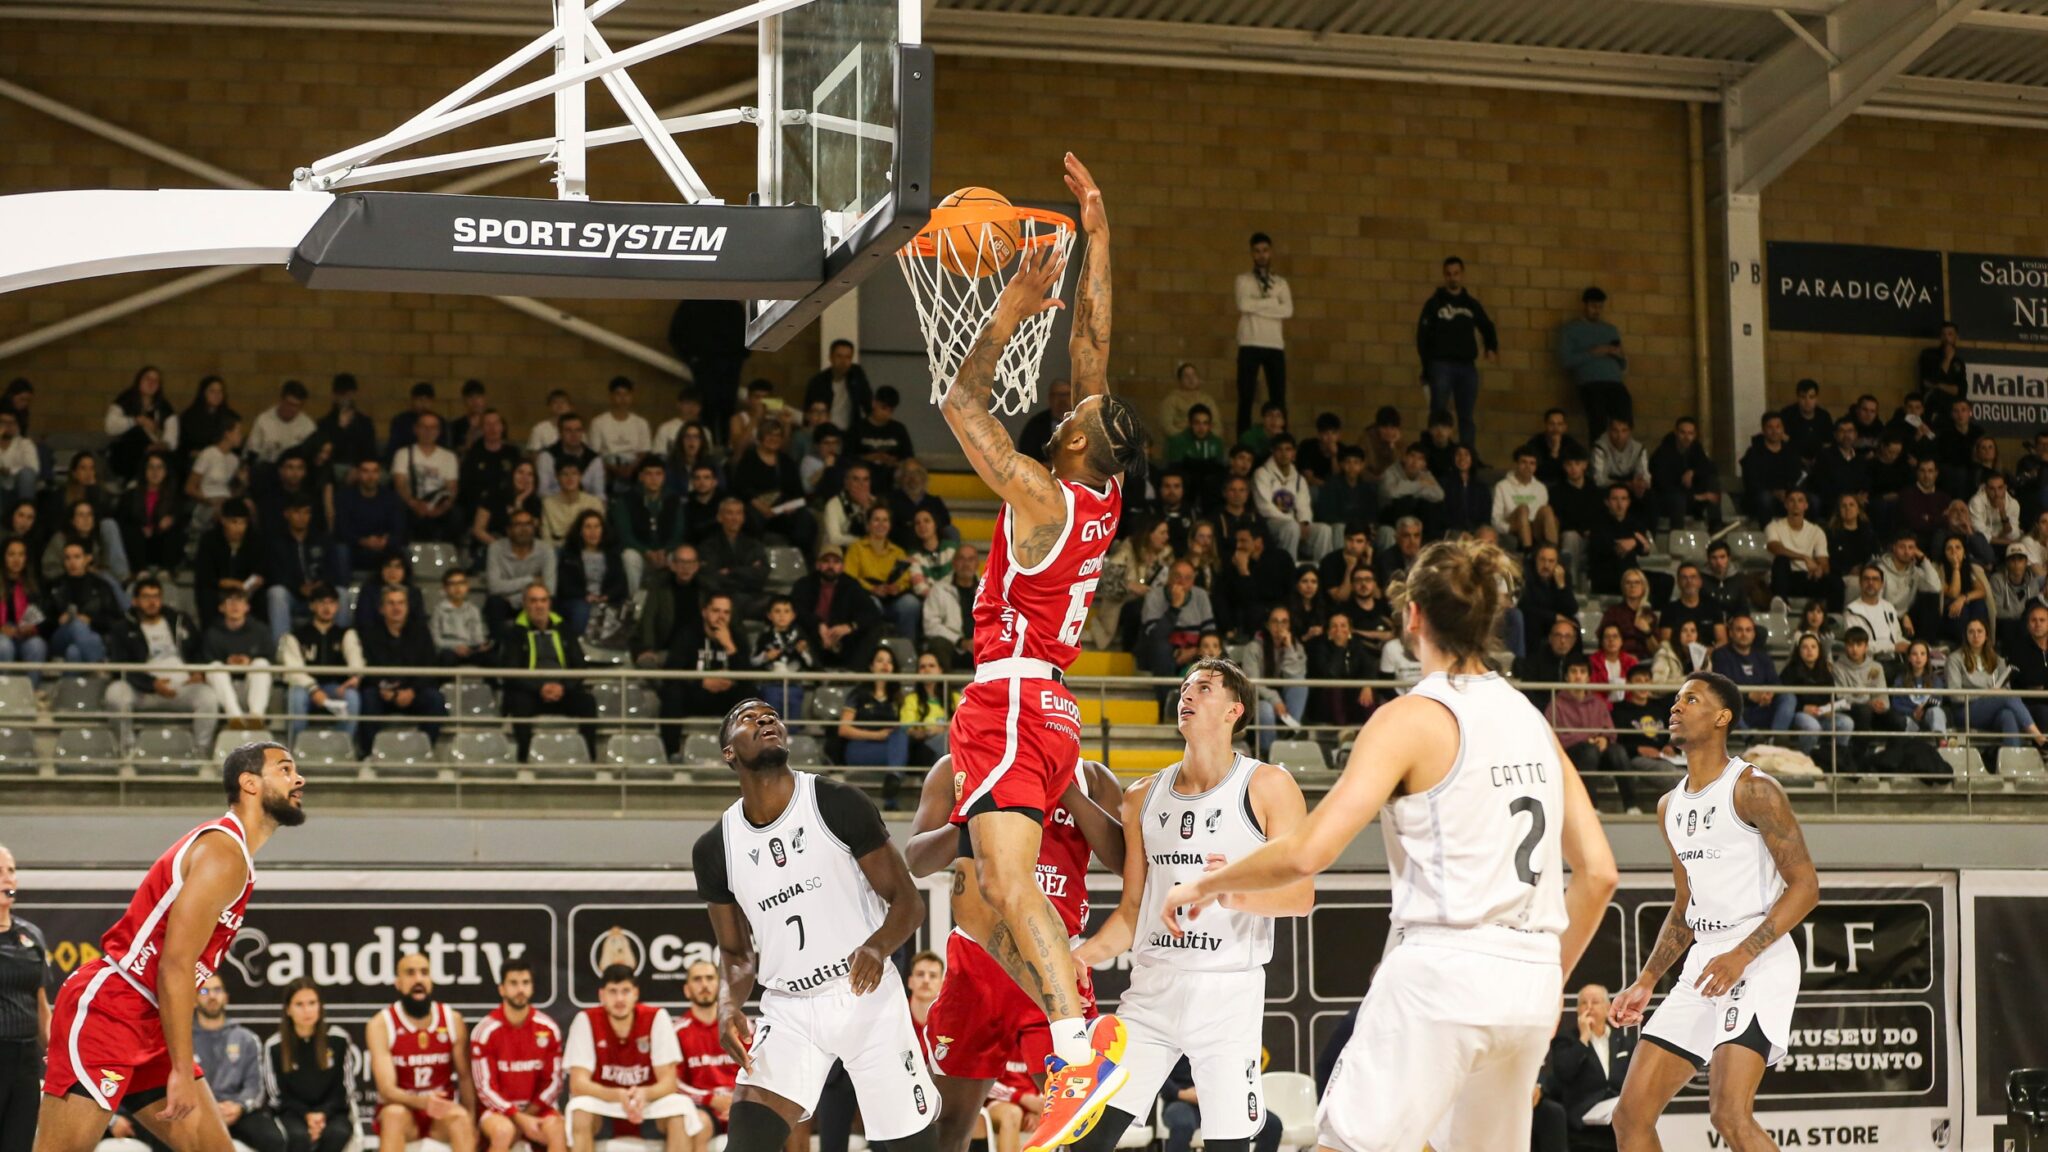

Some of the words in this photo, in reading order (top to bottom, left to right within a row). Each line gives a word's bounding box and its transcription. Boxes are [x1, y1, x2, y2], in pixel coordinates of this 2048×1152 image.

[454, 217, 576, 247] SPORT
[578, 222, 728, 257] SYSTEM
[1973, 372, 2048, 399] Mala
[1973, 403, 2036, 424] ORGULHO
[1058, 578, 1100, 648] 15
[1041, 690, 1081, 722] Europ
[1491, 763, 1546, 787] CATTO
[1509, 796, 1546, 887] 2
[1706, 848, 1721, 859] SC
[1152, 850, 1204, 865] VITÓRIA
[805, 876, 822, 891] SC
[785, 915, 805, 951] 7
[130, 941, 158, 977] Kelly
[650, 934, 721, 972] Ca
[786, 958, 852, 993] auditi
[1788, 1028, 1878, 1047] MUSEU
[1883, 1028, 1918, 1046] DO
[1775, 1052, 1923, 1073] PRESUNTO
[414, 1066, 433, 1088] 12
[1807, 1126, 1879, 1146] STORE
